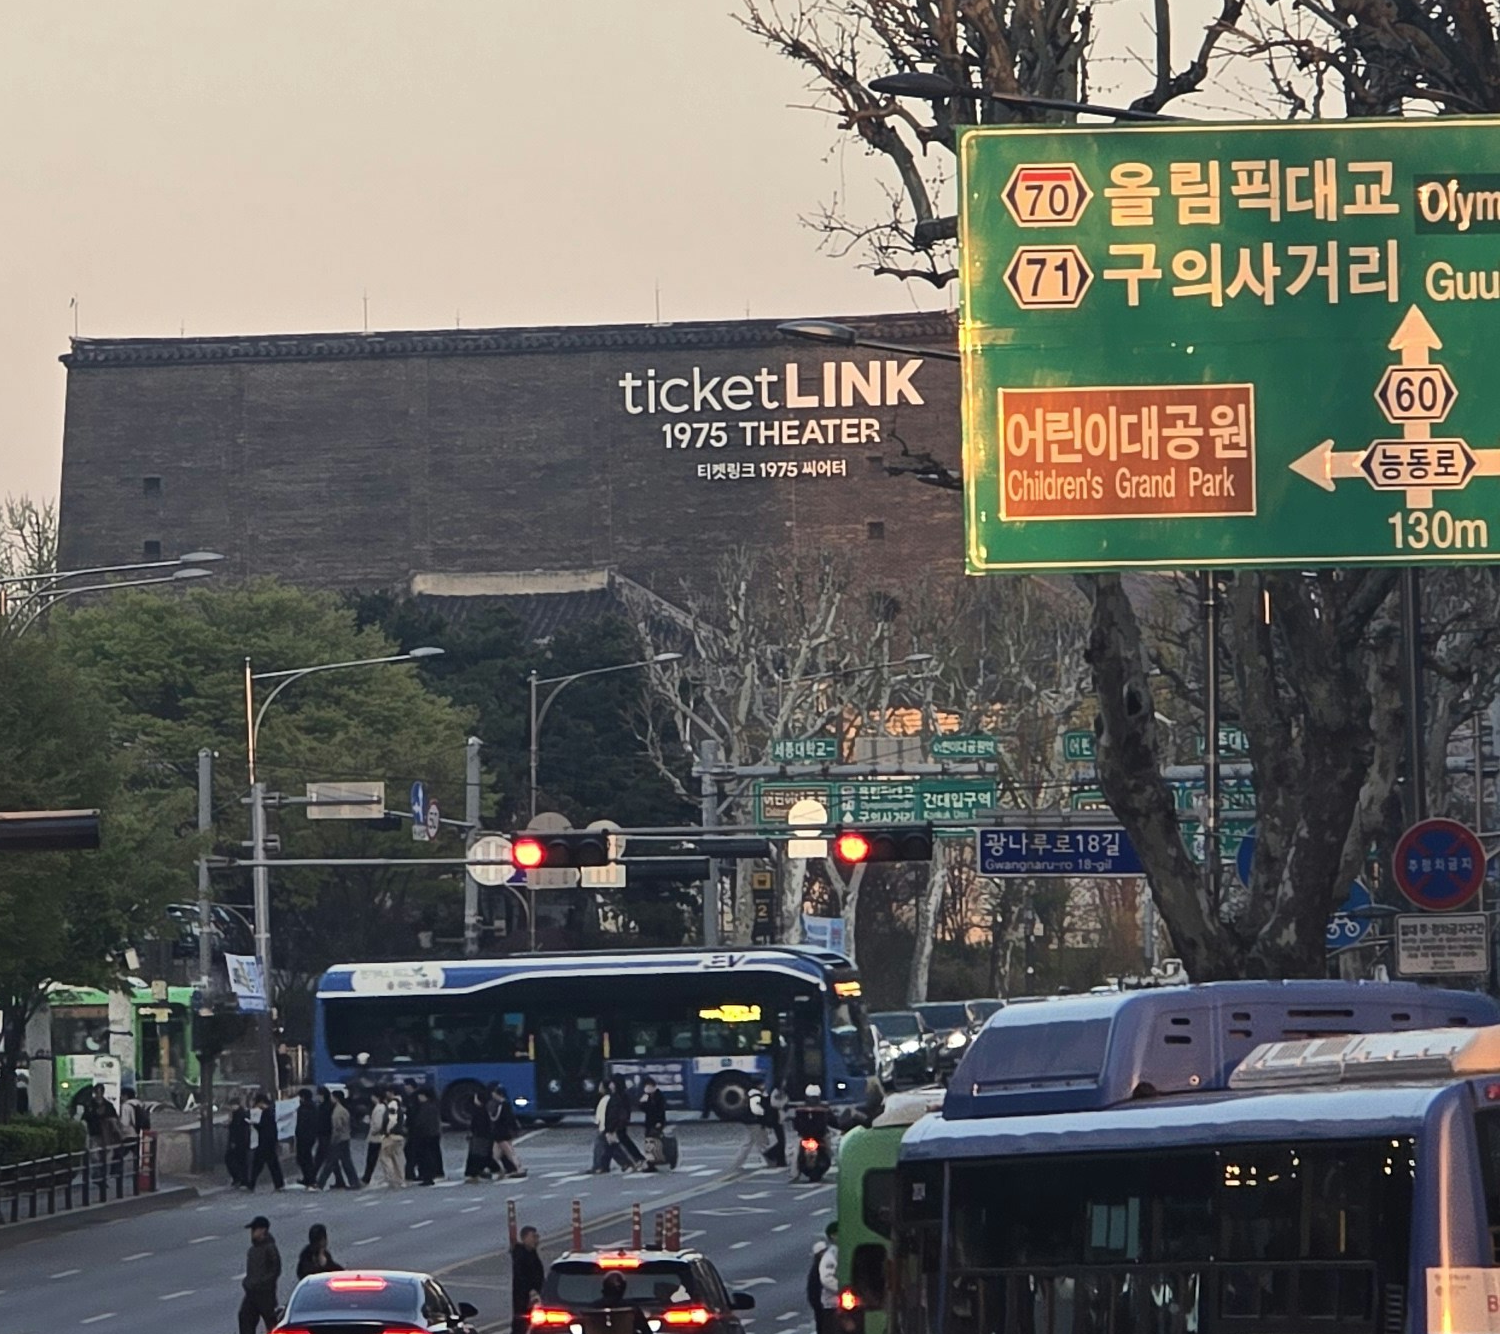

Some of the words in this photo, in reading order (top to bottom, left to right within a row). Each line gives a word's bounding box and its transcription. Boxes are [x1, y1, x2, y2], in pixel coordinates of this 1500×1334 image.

[1025, 184, 1069, 216] 70
[1104, 158, 1400, 226] 올림픽대교
[1028, 258, 1070, 297] 71
[1103, 239, 1399, 307] 구의사거리
[1425, 261, 1500, 301] Guu
[619, 359, 924, 415] ticketLINK
[1396, 378, 1438, 413] 60
[662, 422, 728, 449] 1975
[739, 418, 881, 447] THEATER
[1007, 403, 1248, 463] 어린이대공원
[697, 461, 756, 481] 티켓링크
[760, 461, 798, 478] 1975
[802, 459, 847, 478] 씨어터
[1378, 448, 1460, 480] 능동로
[1007, 468, 1103, 502] Children's
[1115, 468, 1176, 499] Grand
[1188, 467, 1235, 498] Park
[1388, 512, 1487, 548] 130m
[922, 792, 991, 809] 건대입구역
[984, 832, 1120, 857] 광나루로18길
